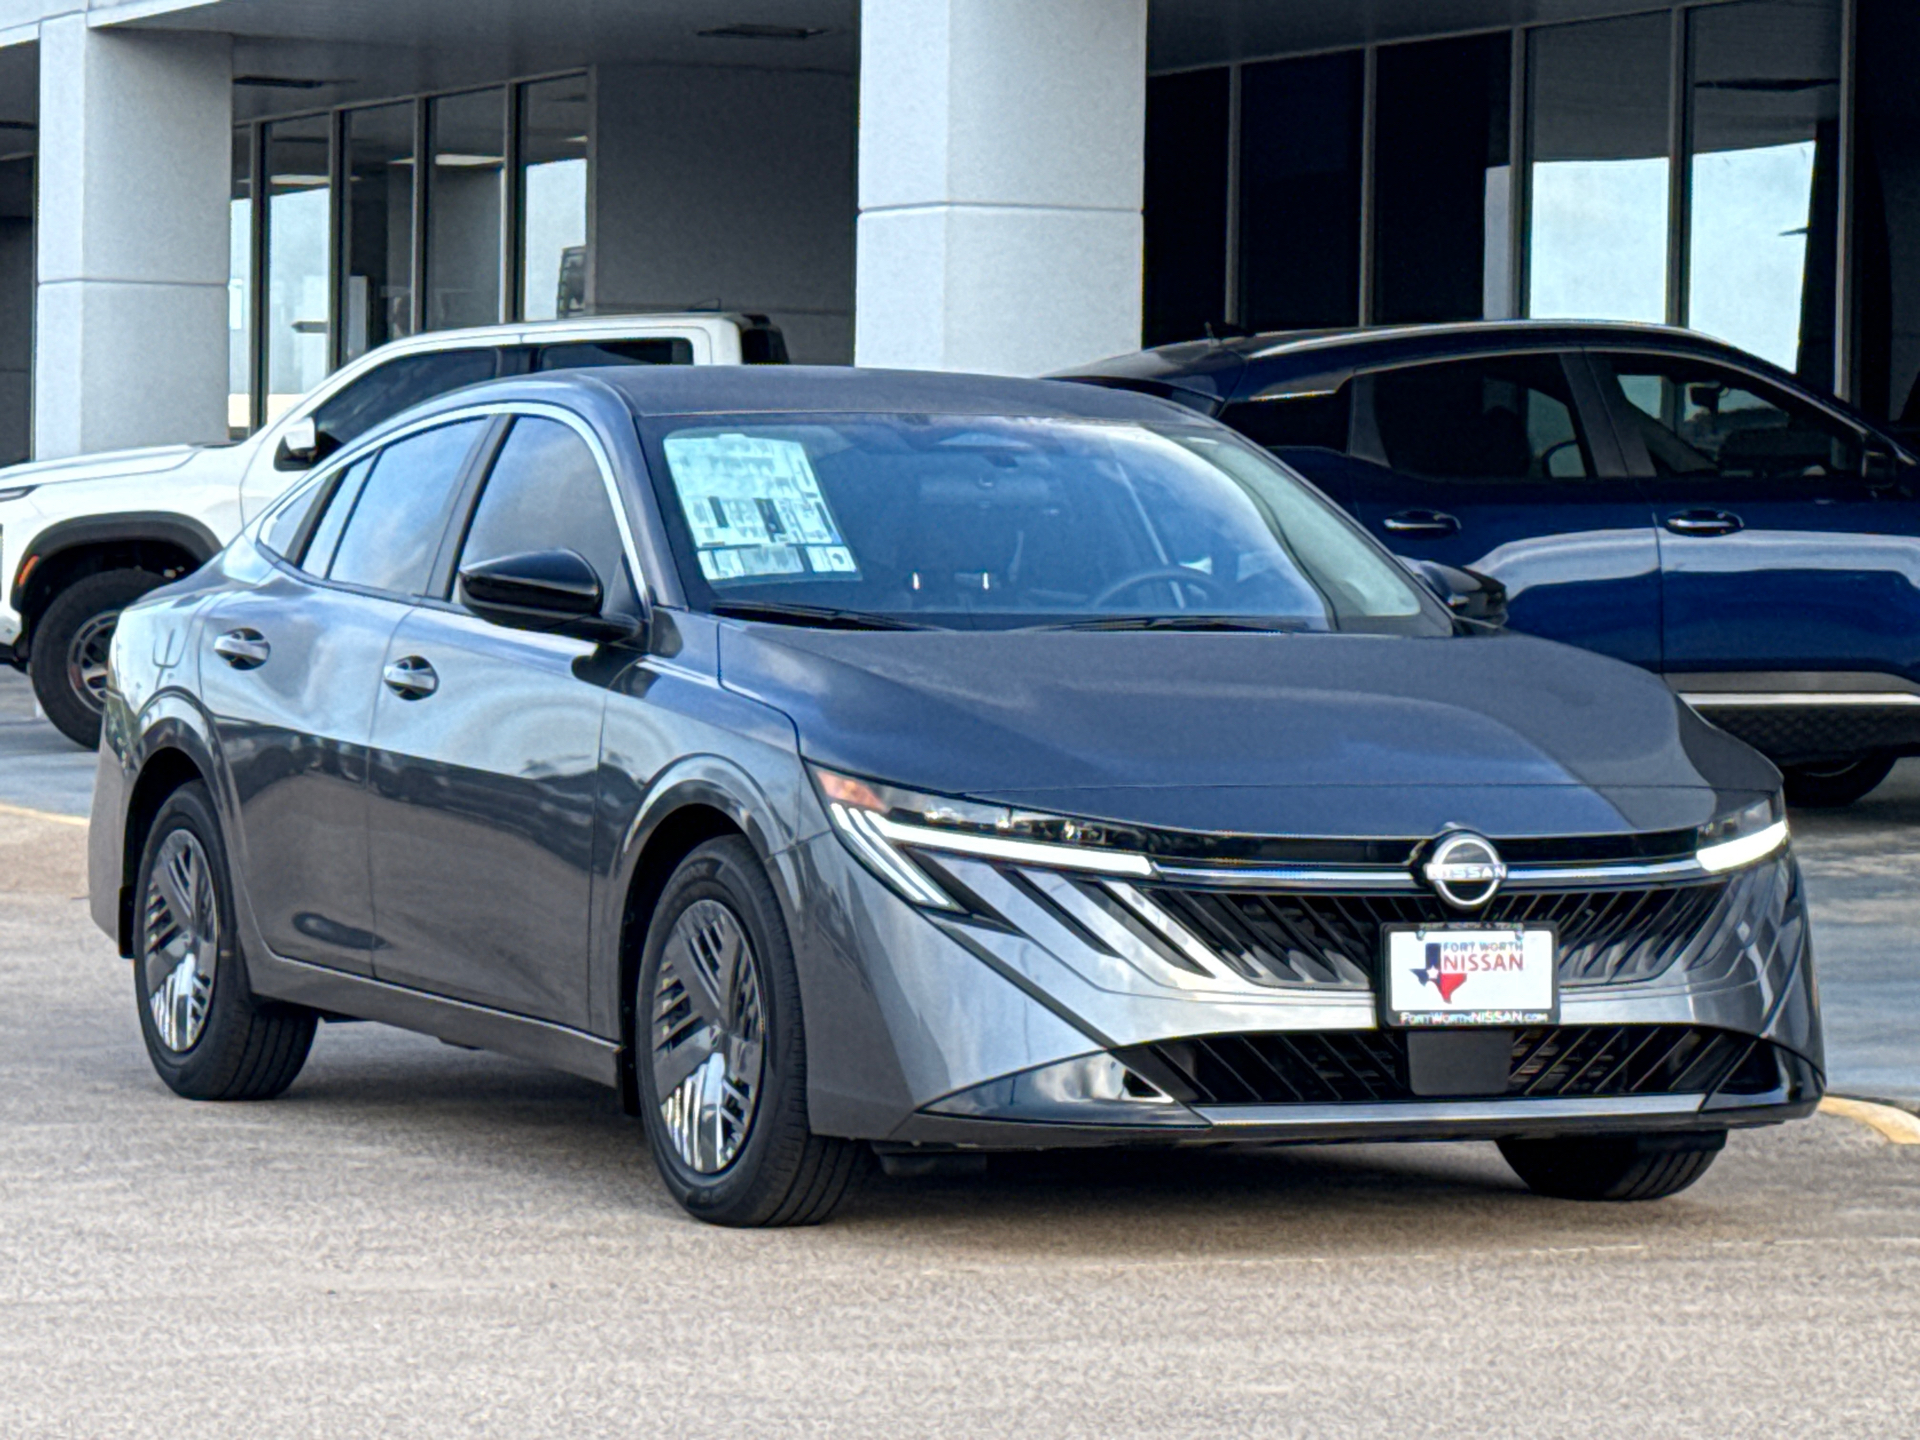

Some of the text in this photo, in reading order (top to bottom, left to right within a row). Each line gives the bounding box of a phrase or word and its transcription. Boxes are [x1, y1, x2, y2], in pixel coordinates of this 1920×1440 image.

[1443, 941, 1523, 953] FORT WORTH
[1443, 954, 1523, 972] NISSAN
